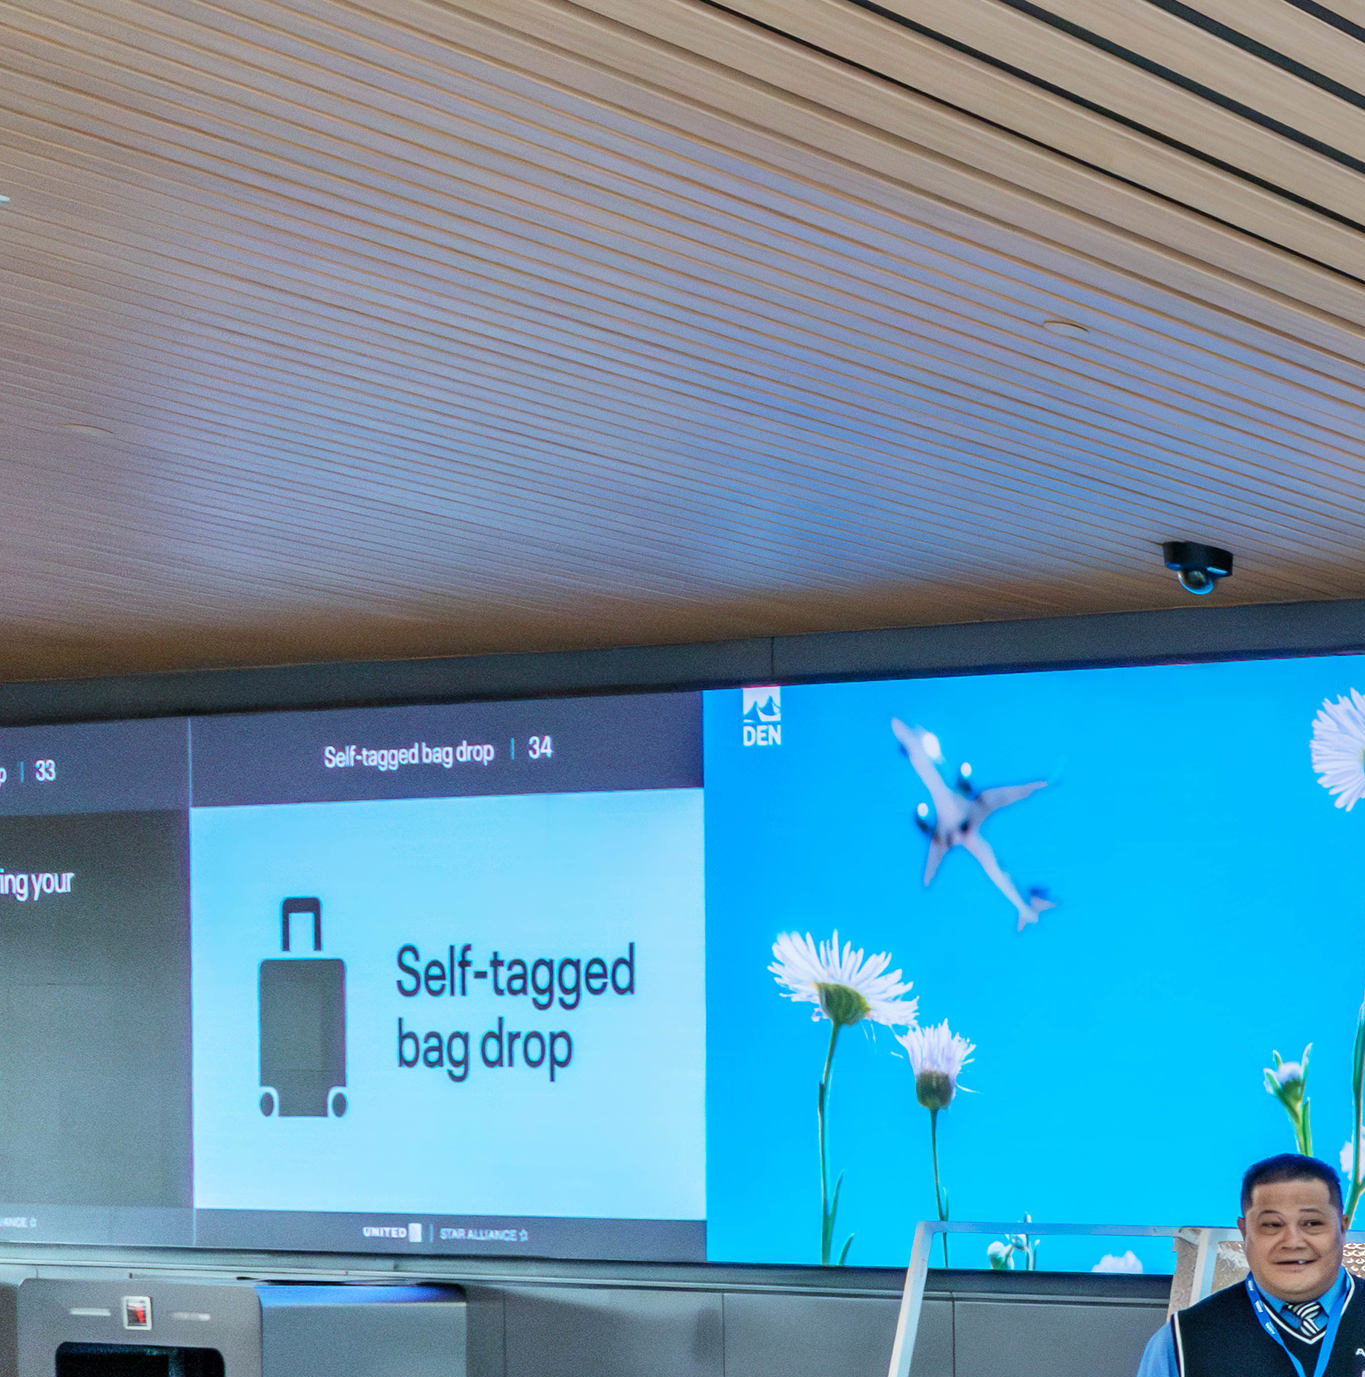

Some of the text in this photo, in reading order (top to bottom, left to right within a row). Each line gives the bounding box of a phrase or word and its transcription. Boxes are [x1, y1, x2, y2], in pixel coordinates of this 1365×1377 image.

[743, 725, 781, 746] DEN
[324, 735, 553, 771] Self-tagged bag drop 34
[35, 760, 56, 781] 33
[31, 871, 75, 901] your
[396, 942, 636, 1010] Self-tagged
[397, 1016, 574, 1082] bag drop
[362, 1226, 518, 1242] UNITED STAR ALLIANCE
